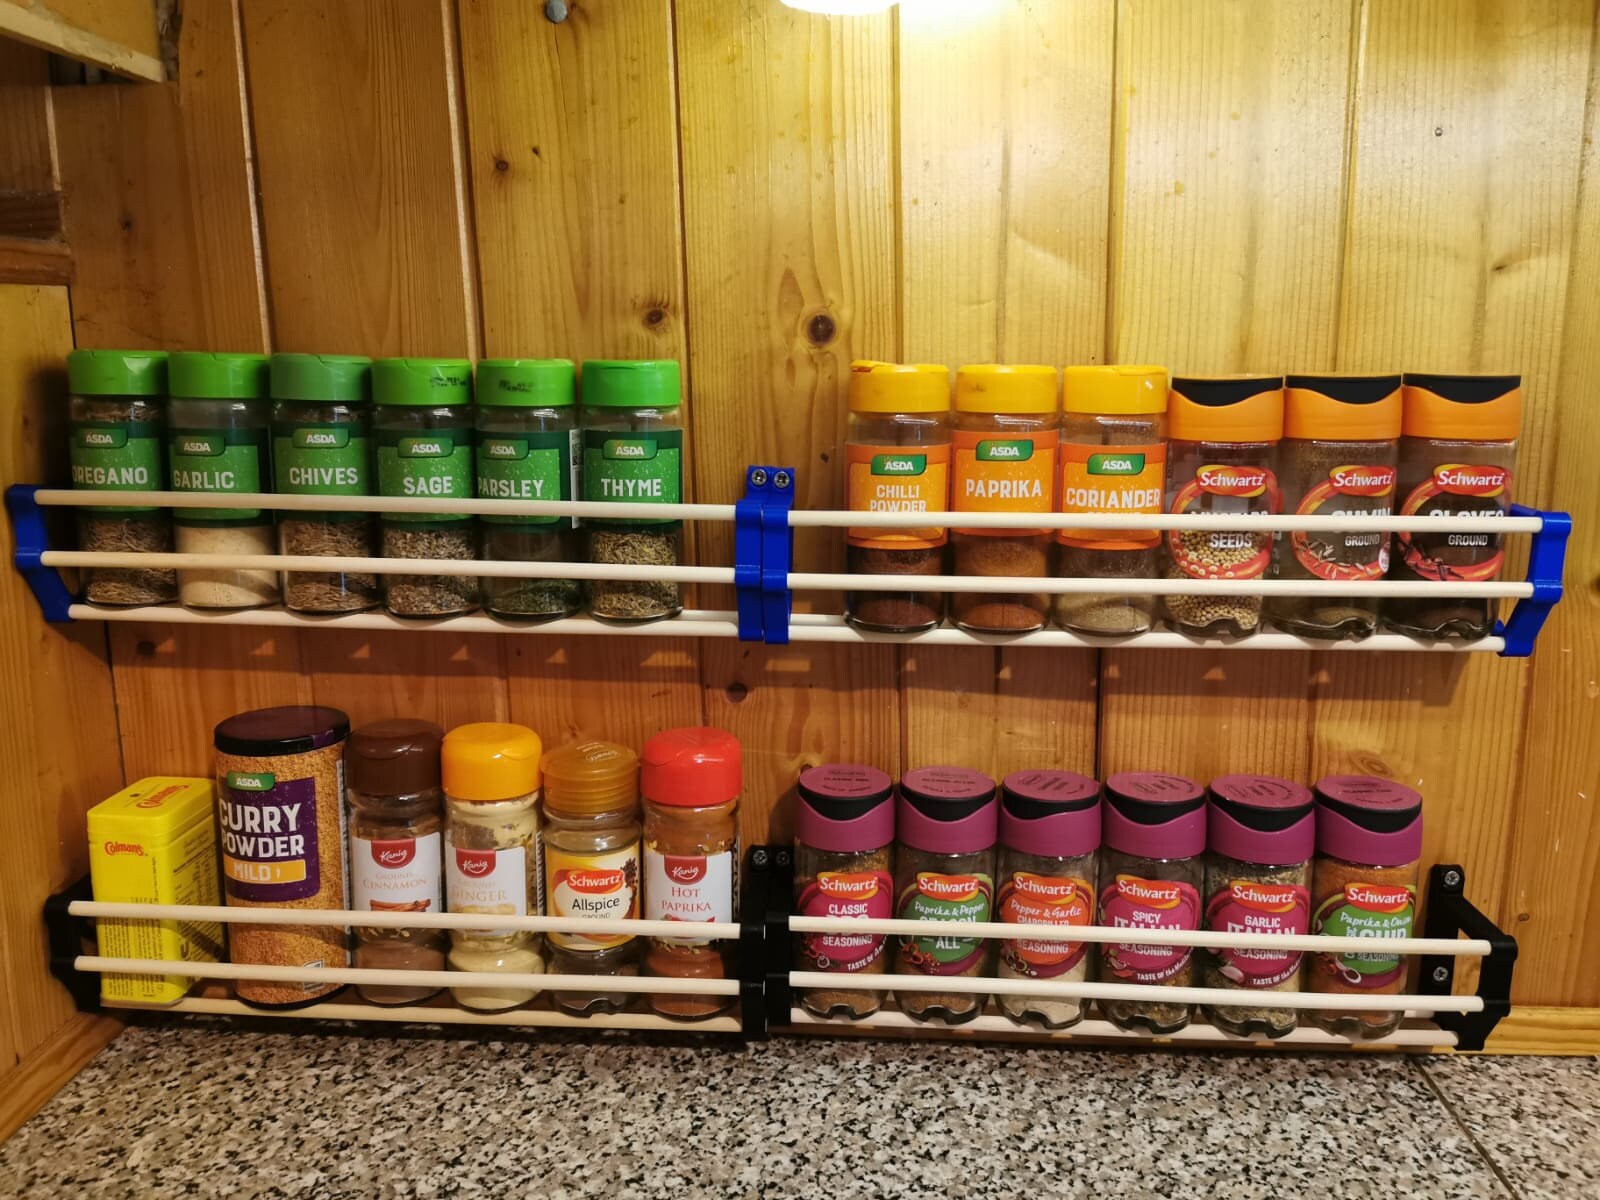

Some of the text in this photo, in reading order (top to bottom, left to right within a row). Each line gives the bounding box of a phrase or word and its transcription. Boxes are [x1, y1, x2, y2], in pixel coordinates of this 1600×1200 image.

[86, 432, 113, 444] ASDA
[306, 432, 336, 444] ASDA
[183, 441, 210, 452] ASDA
[411, 443, 441, 454] ASDA
[490, 445, 516, 456] ASDA
[615, 446, 645, 456] ASDA
[989, 446, 1020, 457] ASDA
[884, 460, 914, 471] ASDA
[1102, 460, 1132, 470] ASDA
[173, 469, 235, 489] GARLIC
[289, 467, 359, 486] CHIVES
[1200, 472, 1266, 487] Schwartz
[1333, 472, 1393, 487] Schwartz
[1437, 471, 1504, 486] Schwartz
[403, 476, 453, 495] SAGE
[477, 477, 544, 498] PARSLEY
[601, 478, 662, 497] THYME
[876, 484, 920, 498] CHILLI
[965, 479, 1042, 499] PAPRIKA
[1066, 487, 1160, 508] CORIANDER
[1209, 533, 1253, 548] SEEDS
[1345, 535, 1380, 546] GROUND
[1448, 535, 1488, 546] GROUND
[235, 777, 262, 788] ASDA
[219, 798, 301, 834] CURRY
[221, 831, 304, 858] POWDER
[233, 861, 272, 881] MILD
[569, 873, 621, 888] Schwartz
[820, 877, 878, 891] Schwartz
[919, 878, 978, 893] Schwartz
[1015, 878, 1074, 895] Schwartz
[671, 886, 701, 898] HOT
[1118, 880, 1179, 899] Schwartz
[1232, 885, 1296, 903] Schwartz
[1348, 888, 1409, 904] Schwartz
[572, 897, 620, 913] Allspice
[661, 901, 712, 913] PAPRIKA
[828, 903, 868, 914] CLASSIC
[915, 901, 951, 915] Paprika
[1011, 899, 1082, 919] Pepper & Garlic
[1132, 911, 1161, 924] SPICY
[1245, 915, 1281, 928] GARLIC
[1340, 911, 1381, 927] Paprika
[823, 935, 872, 947] SEASONING
[936, 936, 960, 949] ALL
[1017, 940, 1069, 954] SEASONING
[1119, 943, 1173, 956] SEASONING
[847, 958, 867, 971] TASTE
[1137, 973, 1157, 981] TASTE
[1252, 977, 1272, 985] TASTE
